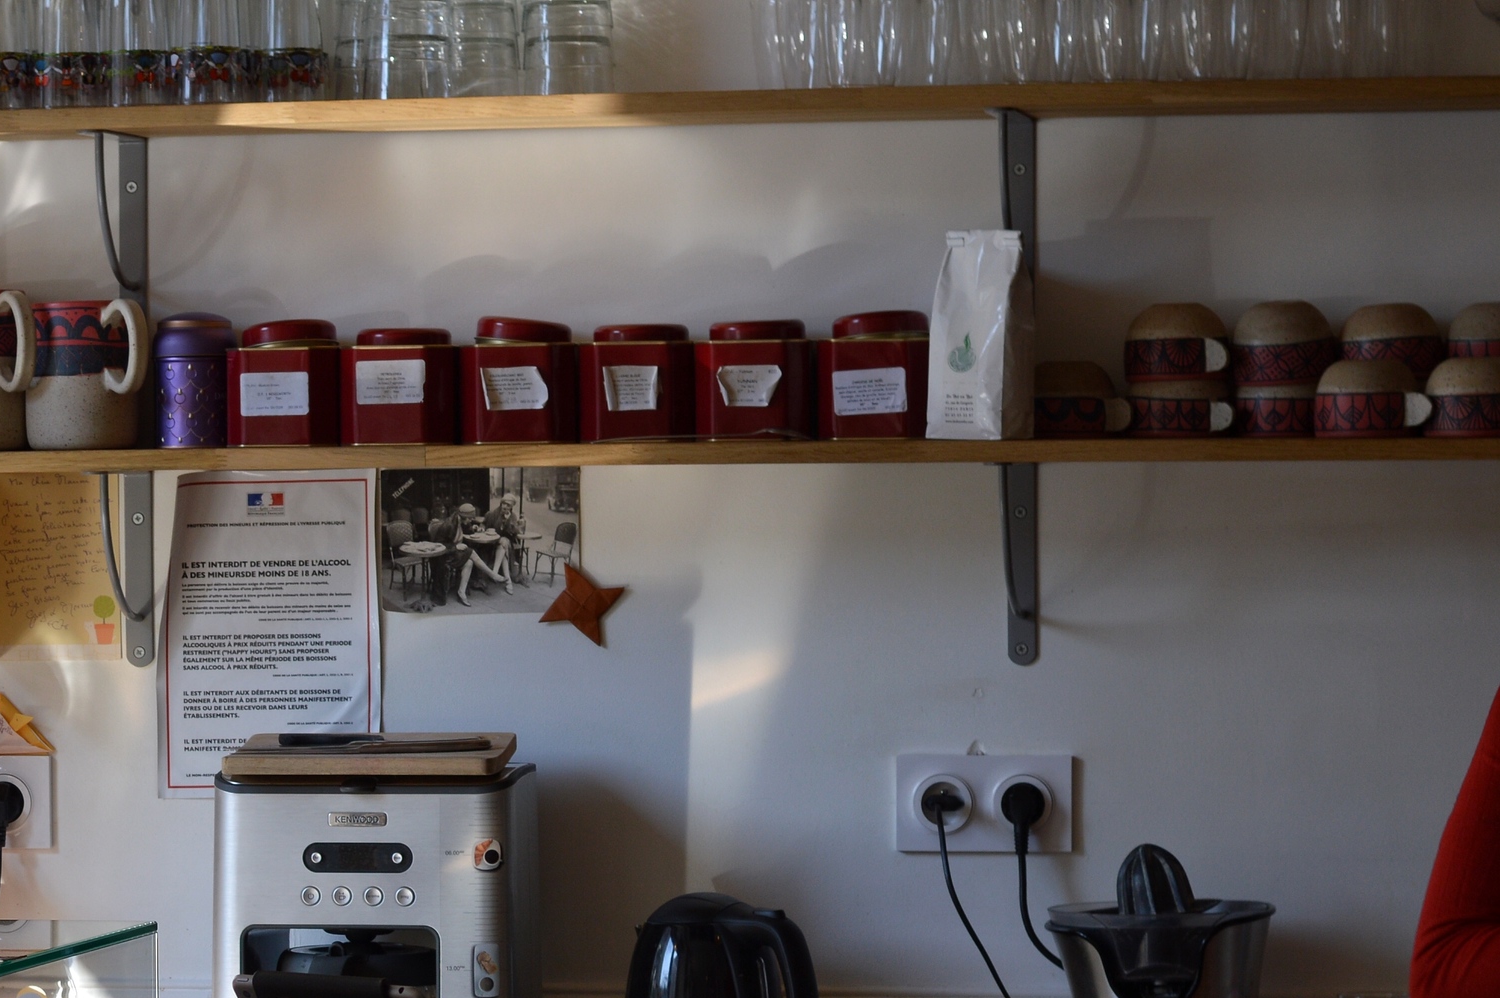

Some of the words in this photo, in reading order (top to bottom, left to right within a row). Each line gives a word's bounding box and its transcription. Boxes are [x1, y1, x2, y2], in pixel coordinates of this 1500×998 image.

[191, 561, 207, 569] EST
[250, 560, 261, 568] DE
[311, 559, 351, 567] L'ALCOOL
[181, 569, 189, 579] À
[190, 571, 206, 579] DES
[258, 570, 286, 578] MOINS
[311, 569, 332, 577] ANS.
[227, 640, 232, 648] À
[249, 662, 279, 670] RÉDUITS.
[251, 688, 288, 696] DÉBITANTS
[212, 696, 217, 704] À
[334, 815, 379, 825] KENWOOD
